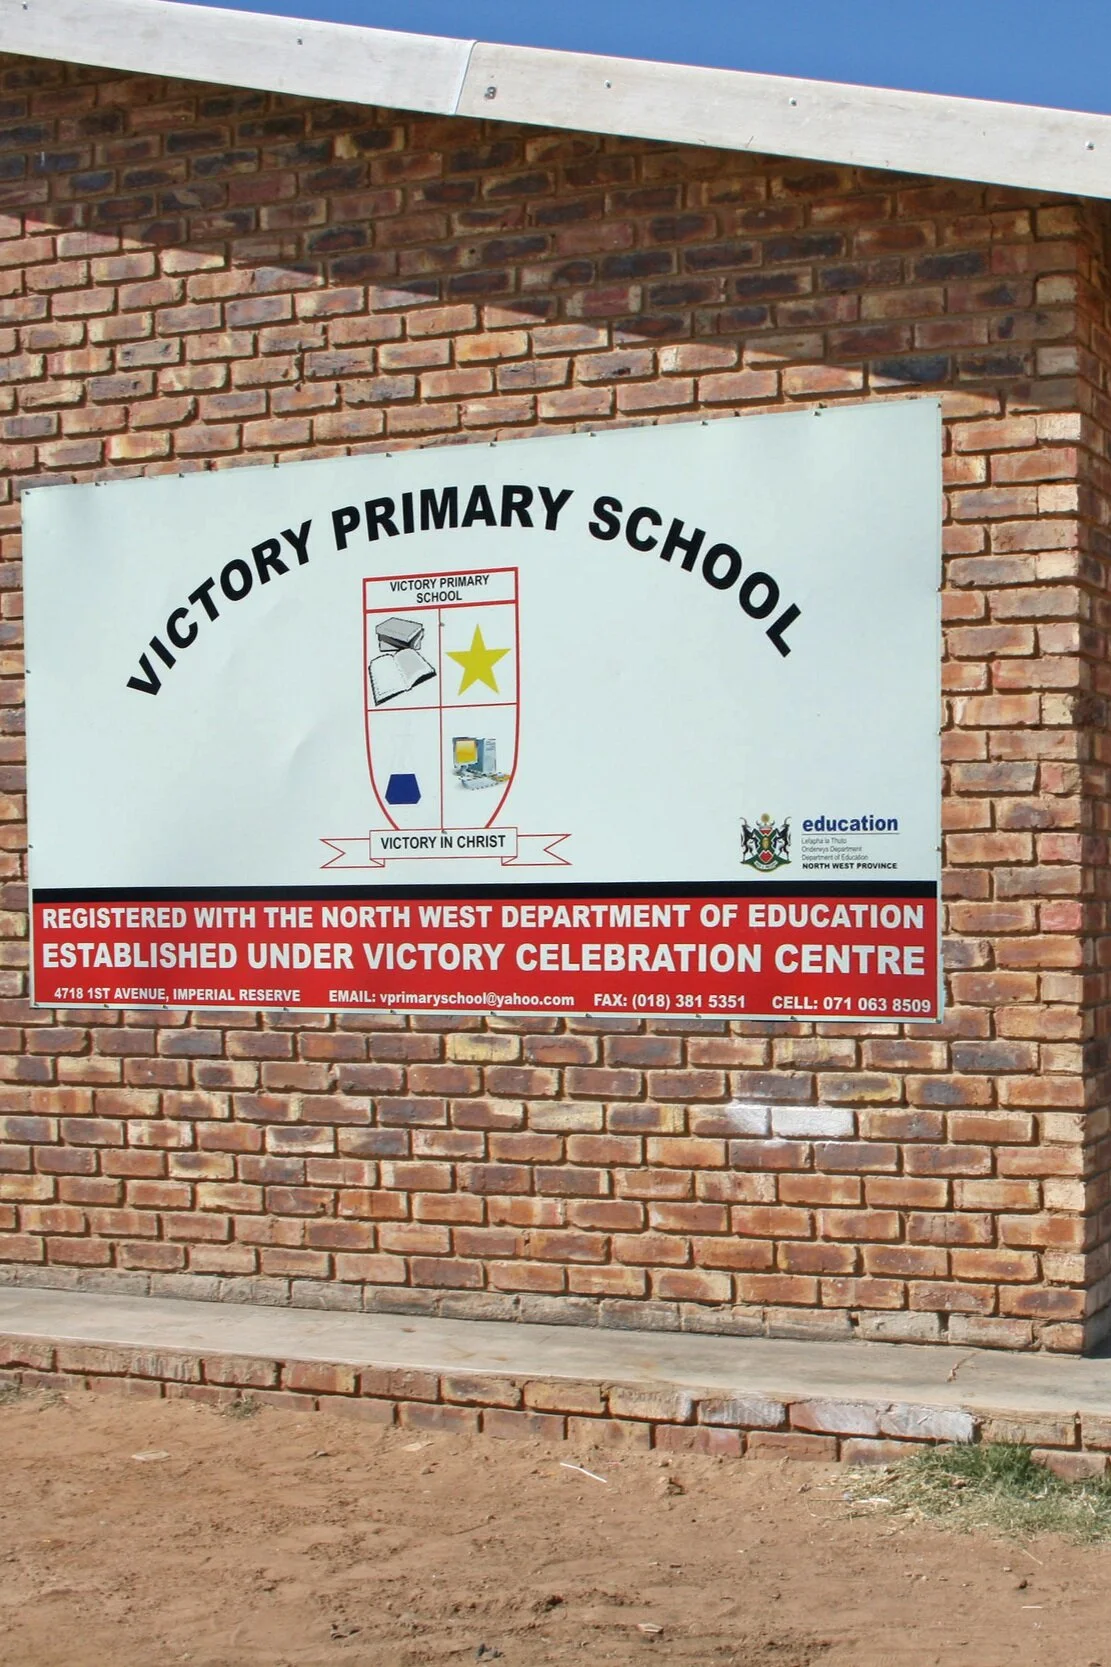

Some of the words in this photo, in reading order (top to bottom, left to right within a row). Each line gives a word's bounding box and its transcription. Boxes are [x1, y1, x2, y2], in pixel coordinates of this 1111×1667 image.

[126, 519, 313, 696] VICTORY
[331, 484, 575, 551] PRIMARY
[588, 495, 802, 658] SCHOOL
[389, 577, 437, 592] VICTORY
[439, 574, 490, 589] PRIMARY
[416, 590, 463, 604] SCHOOL
[802, 814, 898, 832] education
[380, 836, 437, 850] VICTORY
[440, 836, 453, 849] IN
[456, 834, 506, 849] CHRIST
[802, 862, 830, 870] NORTH
[831, 862, 855, 870] WEST
[856, 862, 897, 870] PROVINCE
[841, 853, 869, 861] Education
[42, 907, 187, 929] REGISTERED
[193, 906, 256, 929] WITH
[263, 906, 314, 929] THE
[321, 905, 411, 929] NORTH
[418, 905, 493, 929] WEST
[501, 904, 691, 928] DEPARTMENT
[699, 903, 739, 928] OF
[748, 903, 924, 929] EDUCATION
[42, 942, 238, 969] ESTABLISHED
[247, 942, 355, 970] UNDER
[362, 942, 506, 971] VICTORY
[515, 942, 762, 973] CELEBRATION
[774, 943, 925, 976] CENTRE
[53, 987, 84, 1000] 4718
[87, 987, 111, 1000] 1ST
[113, 988, 169, 1002] AVENUE,
[172, 988, 236, 1001] IMPERIAL
[238, 988, 301, 1002] RESERVE
[328, 989, 376, 1003] EMAIL:
[379, 990, 575, 1008] vprimaryschool@yahoo.com
[593, 993, 628, 1007] FAX:
[632, 993, 671, 1010] (018)
[675, 994, 702, 1008] 381
[708, 994, 746, 1009] 5351
[771, 995, 818, 1010] CELL:
[822, 996, 852, 1011] 071
[857, 997, 888, 1012] 063
[892, 998, 932, 1013] 8509
